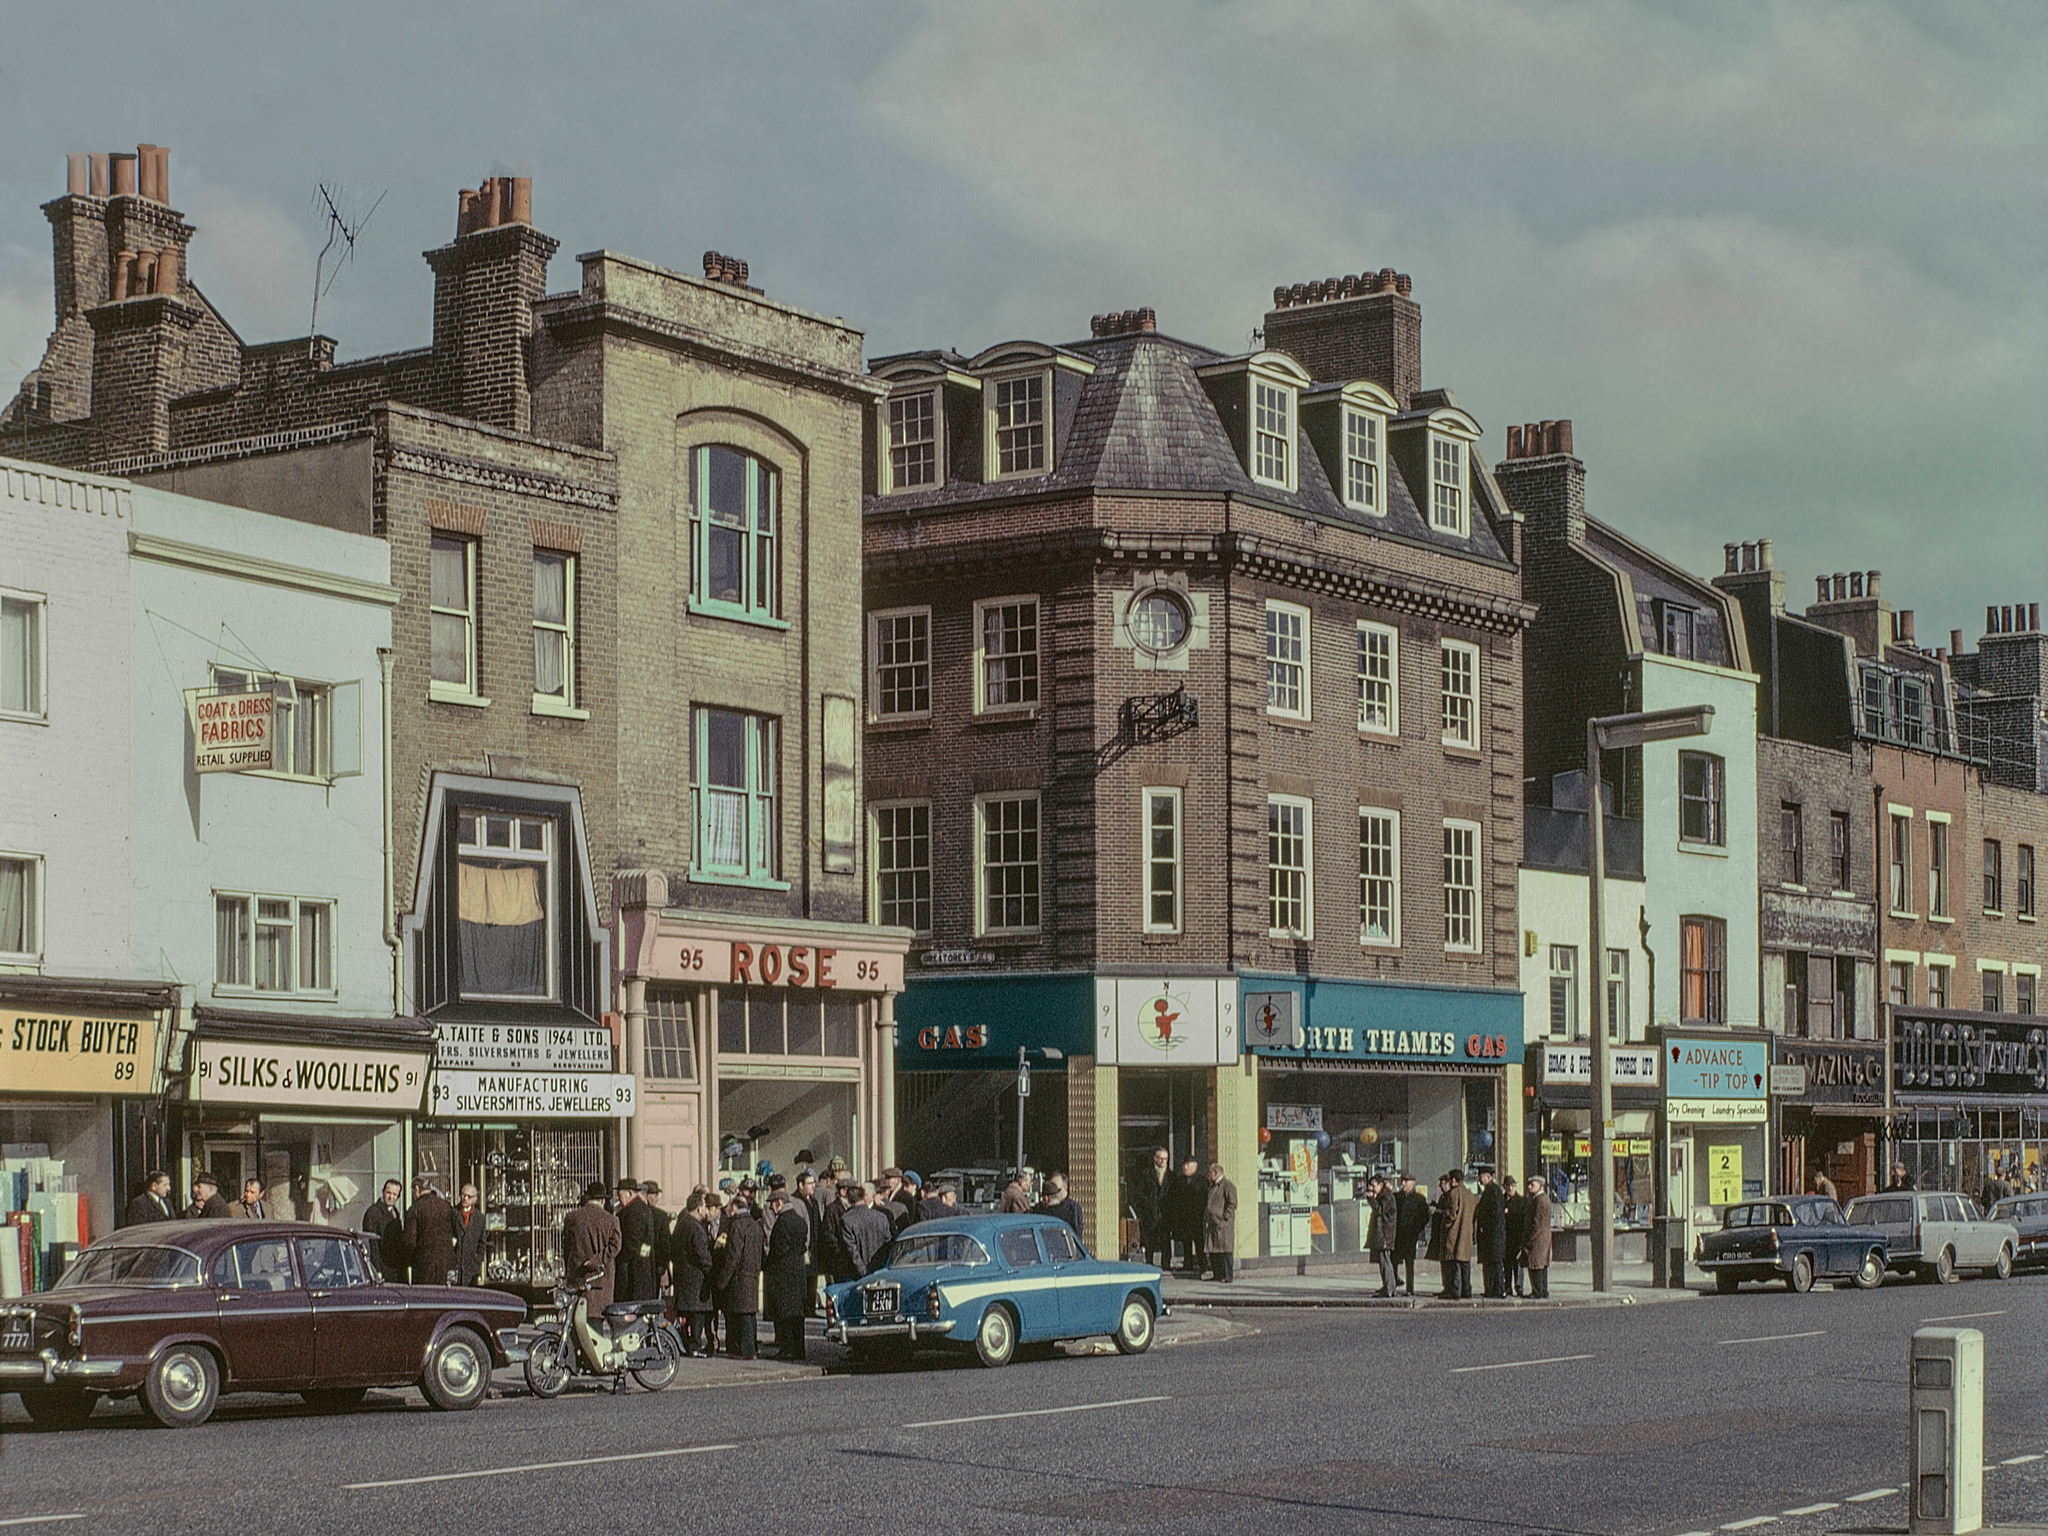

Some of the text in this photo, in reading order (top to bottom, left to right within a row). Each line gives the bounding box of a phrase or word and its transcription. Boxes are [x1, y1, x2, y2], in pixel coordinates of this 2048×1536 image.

[198, 697, 271, 719] COAT & DRESS
[201, 717, 264, 742] FABRICS
[196, 750, 271, 766] RETAIL SUPPLIED
[680, 942, 880, 988] 95 ROSE 95
[12, 1018, 72, 1052] STOCK
[80, 1020, 139, 1055] BUYER
[507, 1028, 539, 1044] SONS
[583, 1031, 607, 1047] LTD.
[918, 1024, 987, 1050] GAS
[1294, 1026, 1507, 1056] RTH THAMES GAS
[440, 1046, 463, 1058] FRS.
[469, 1046, 540, 1060] SILVERSMITHS
[558, 1048, 610, 1061] JEWELLERS
[1685, 1048, 1743, 1067] ADVANCE
[114, 1061, 134, 1080] 89
[200, 1056, 419, 1094] 91 SILKS & WOOLLENS 91
[432, 1076, 588, 1101] 93 MANUFACTURING
[1725, 1073, 1748, 1090] TOP
[548, 1097, 611, 1112] JEWELLERS
[616, 1088, 631, 1103] 93
[1668, 1102, 1765, 1118] Dry Cleaning Laundry Specialists
[1721, 1155, 1730, 1170] 2
[1722, 1187, 1728, 1202] 1
[12, 1320, 21, 1332] L
[3, 1332, 30, 1347] 7777
